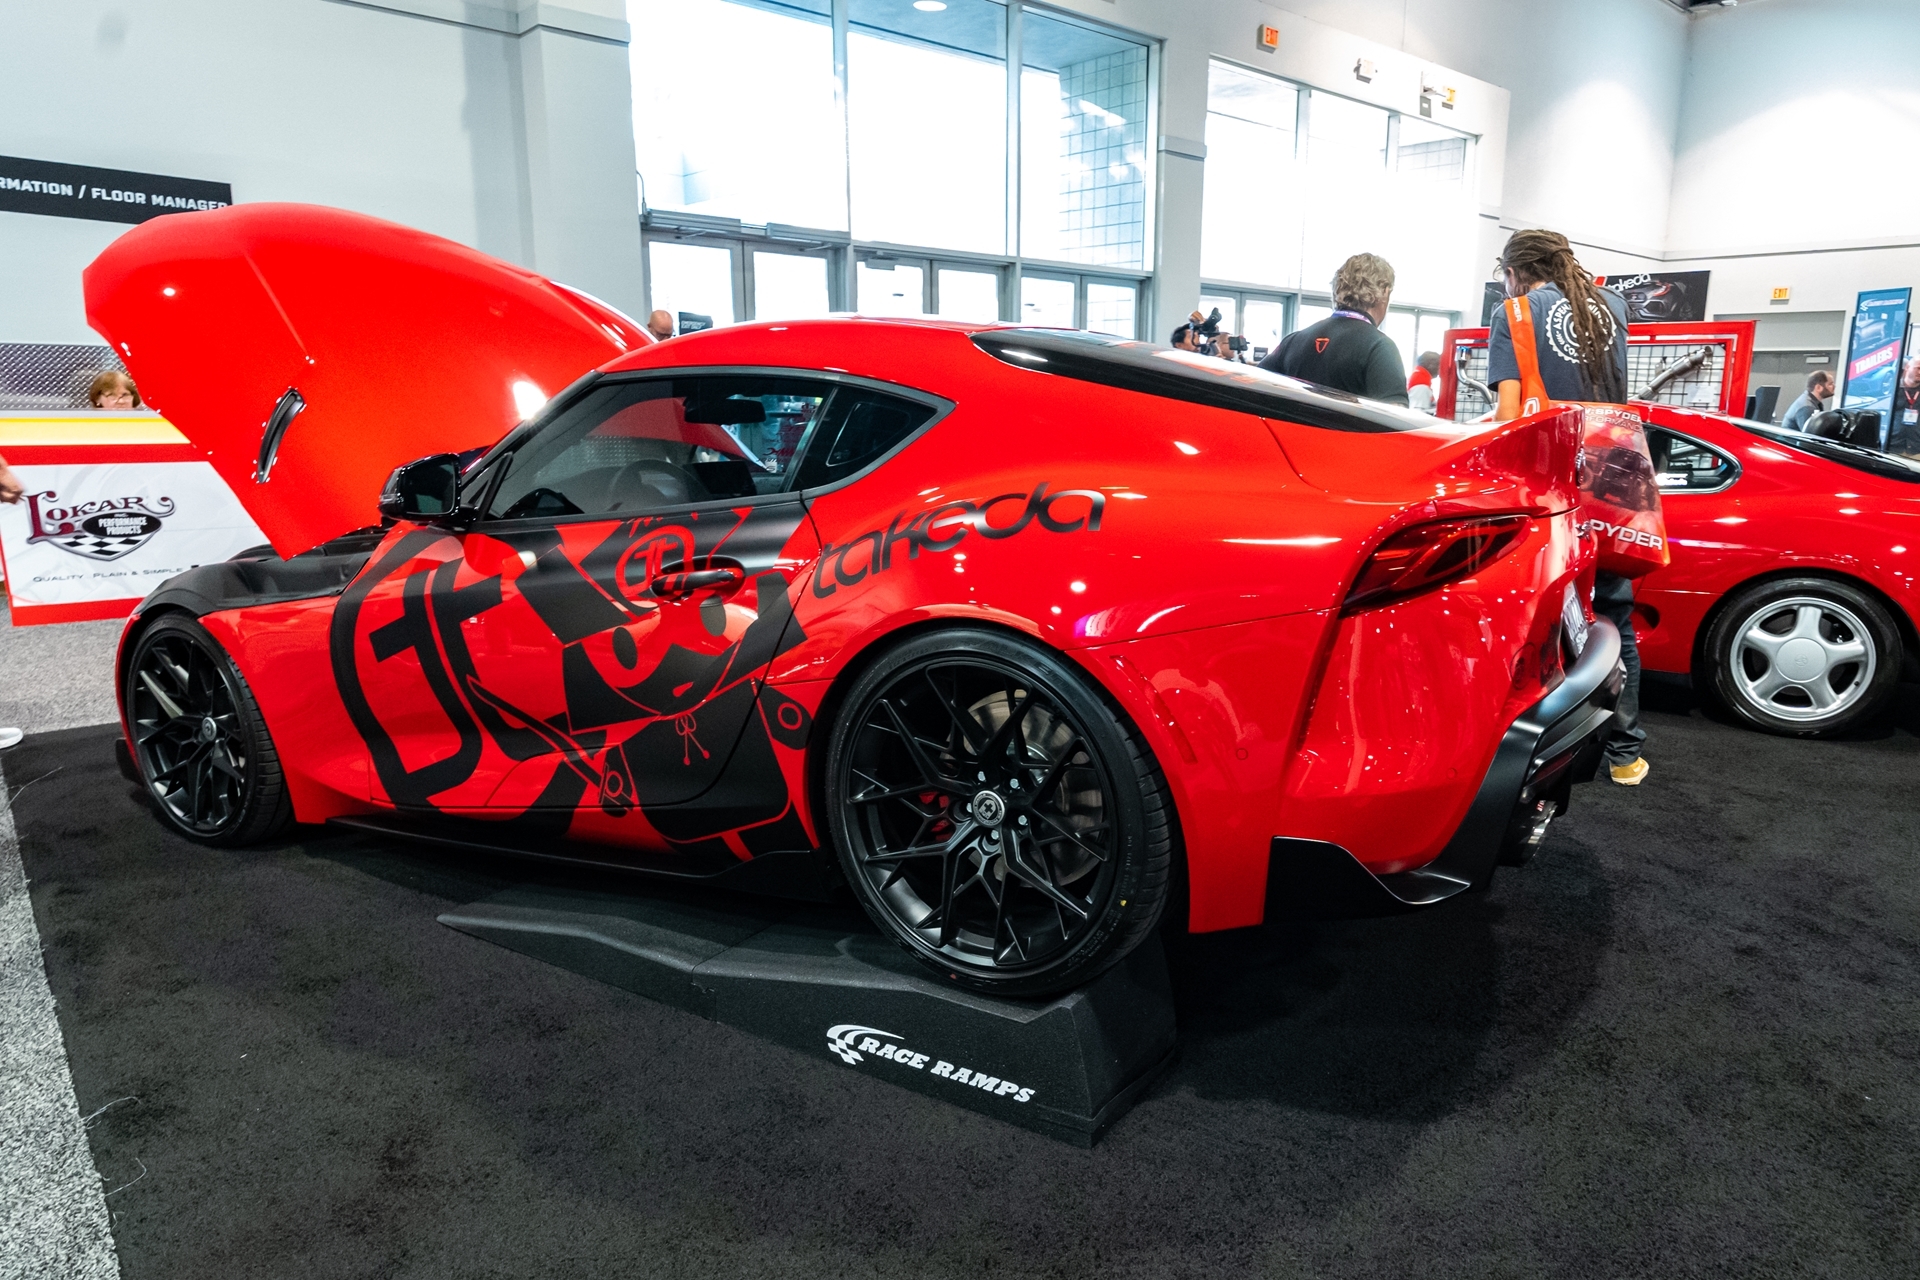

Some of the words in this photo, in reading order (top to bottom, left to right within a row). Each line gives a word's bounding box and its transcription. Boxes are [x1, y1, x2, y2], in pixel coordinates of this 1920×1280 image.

[78, 185, 87, 200] /
[91, 187, 146, 205] FLOOR
[1553, 303, 1572, 330] ASPEN
[24, 490, 176, 543] LOKAR
[98, 516, 148, 528] PERFORMANCE
[106, 526, 142, 536] PRODUCTS
[812, 482, 1106, 599] takeda
[858, 1036, 930, 1069] RACE
[930, 1060, 1036, 1102] RAMPS
